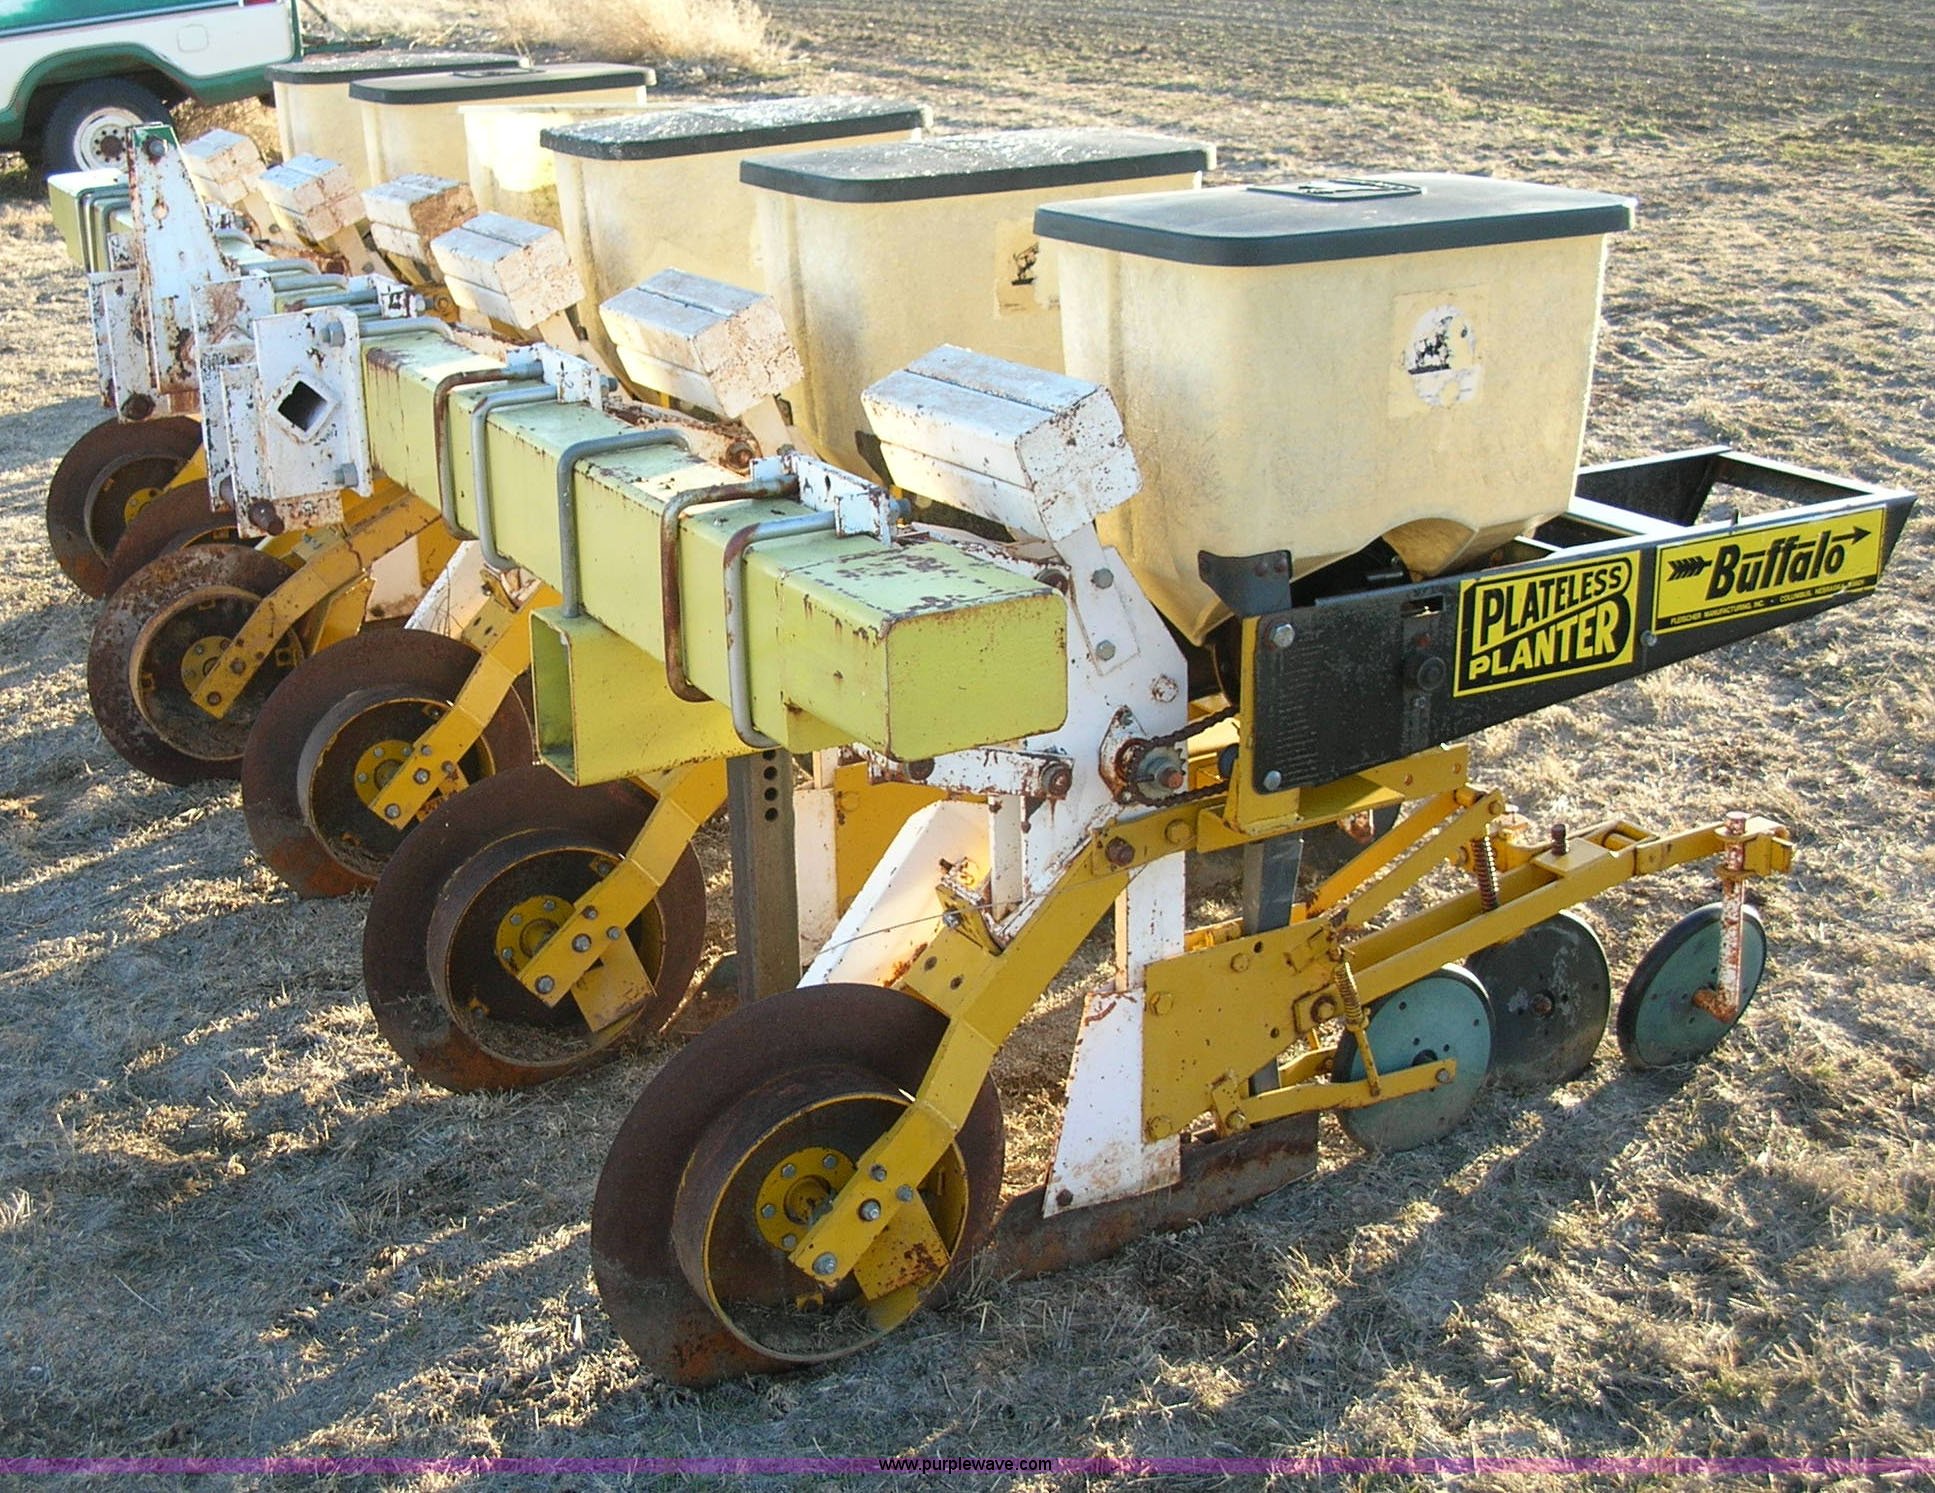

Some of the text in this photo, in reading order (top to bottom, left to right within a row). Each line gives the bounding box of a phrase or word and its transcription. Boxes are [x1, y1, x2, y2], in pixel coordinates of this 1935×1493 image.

[1706, 531, 1845, 600] Buffalo
[1469, 600, 1619, 681] PLANTER
[1479, 567, 1623, 647] PLATELESS
